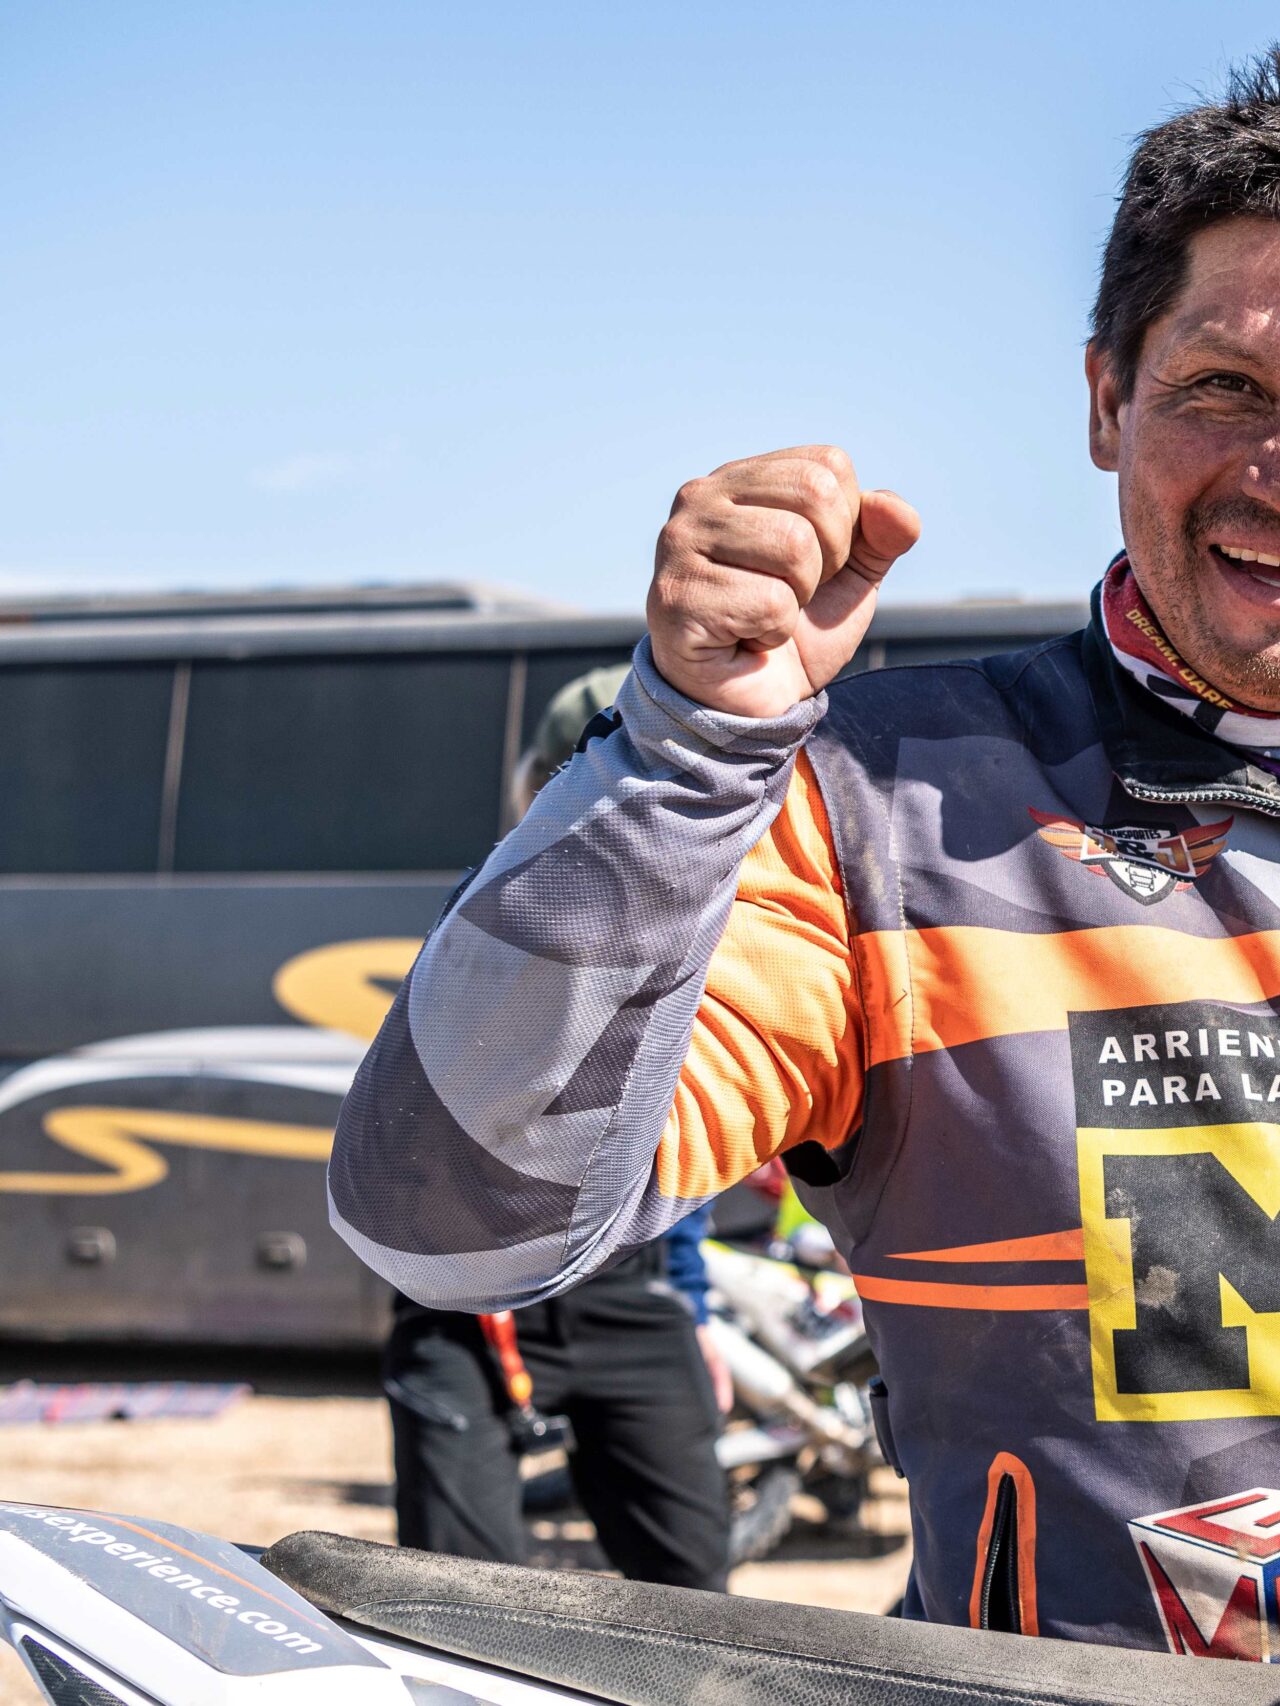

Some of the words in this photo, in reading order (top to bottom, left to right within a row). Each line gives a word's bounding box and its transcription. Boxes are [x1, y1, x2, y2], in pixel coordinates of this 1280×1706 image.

[1126, 608, 1180, 667] DREAM.
[1103, 829, 1162, 840] TRANSPORTES
[1103, 1075, 1222, 1107] PARA
[0, 1504, 324, 1655] sexperience.com
